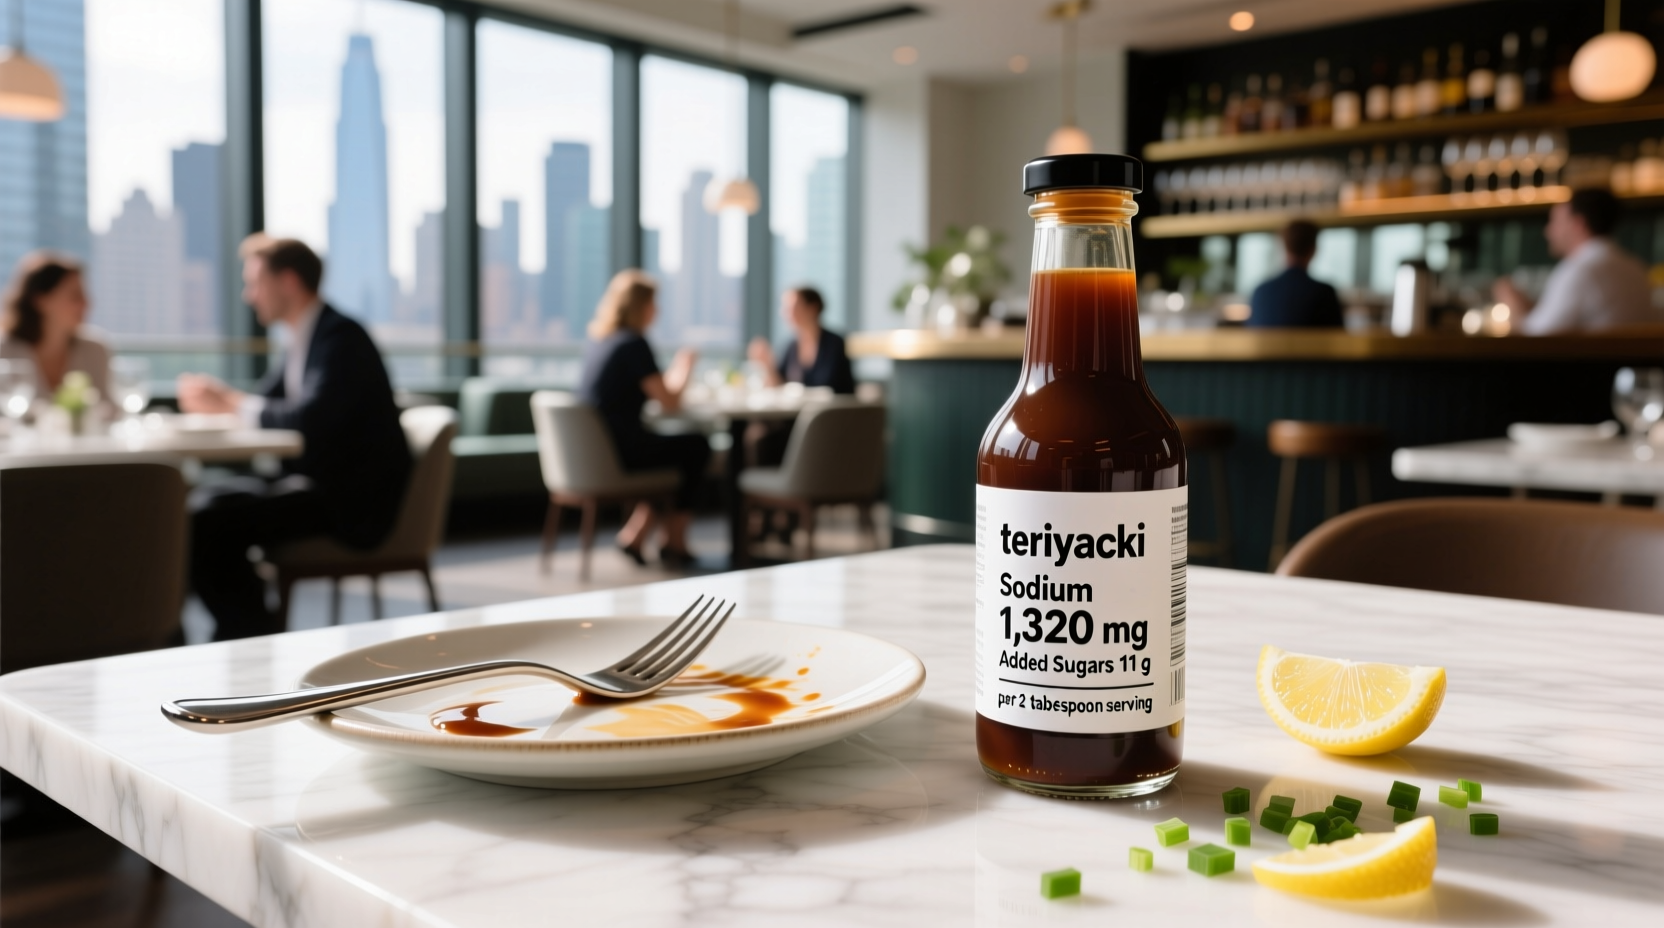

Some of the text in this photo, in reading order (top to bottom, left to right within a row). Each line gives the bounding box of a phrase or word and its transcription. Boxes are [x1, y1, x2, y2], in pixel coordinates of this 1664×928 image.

[1000, 522, 1146, 567] teriyacki
[1000, 572, 1093, 602] Sodium
[999, 606, 1149, 651] 1,320 mg
[998, 650, 1151, 678] Added Sugars 11 g
[998, 693, 1017, 709] per
[1018, 693, 1026, 708] 2
[1106, 695, 1152, 714] serving
